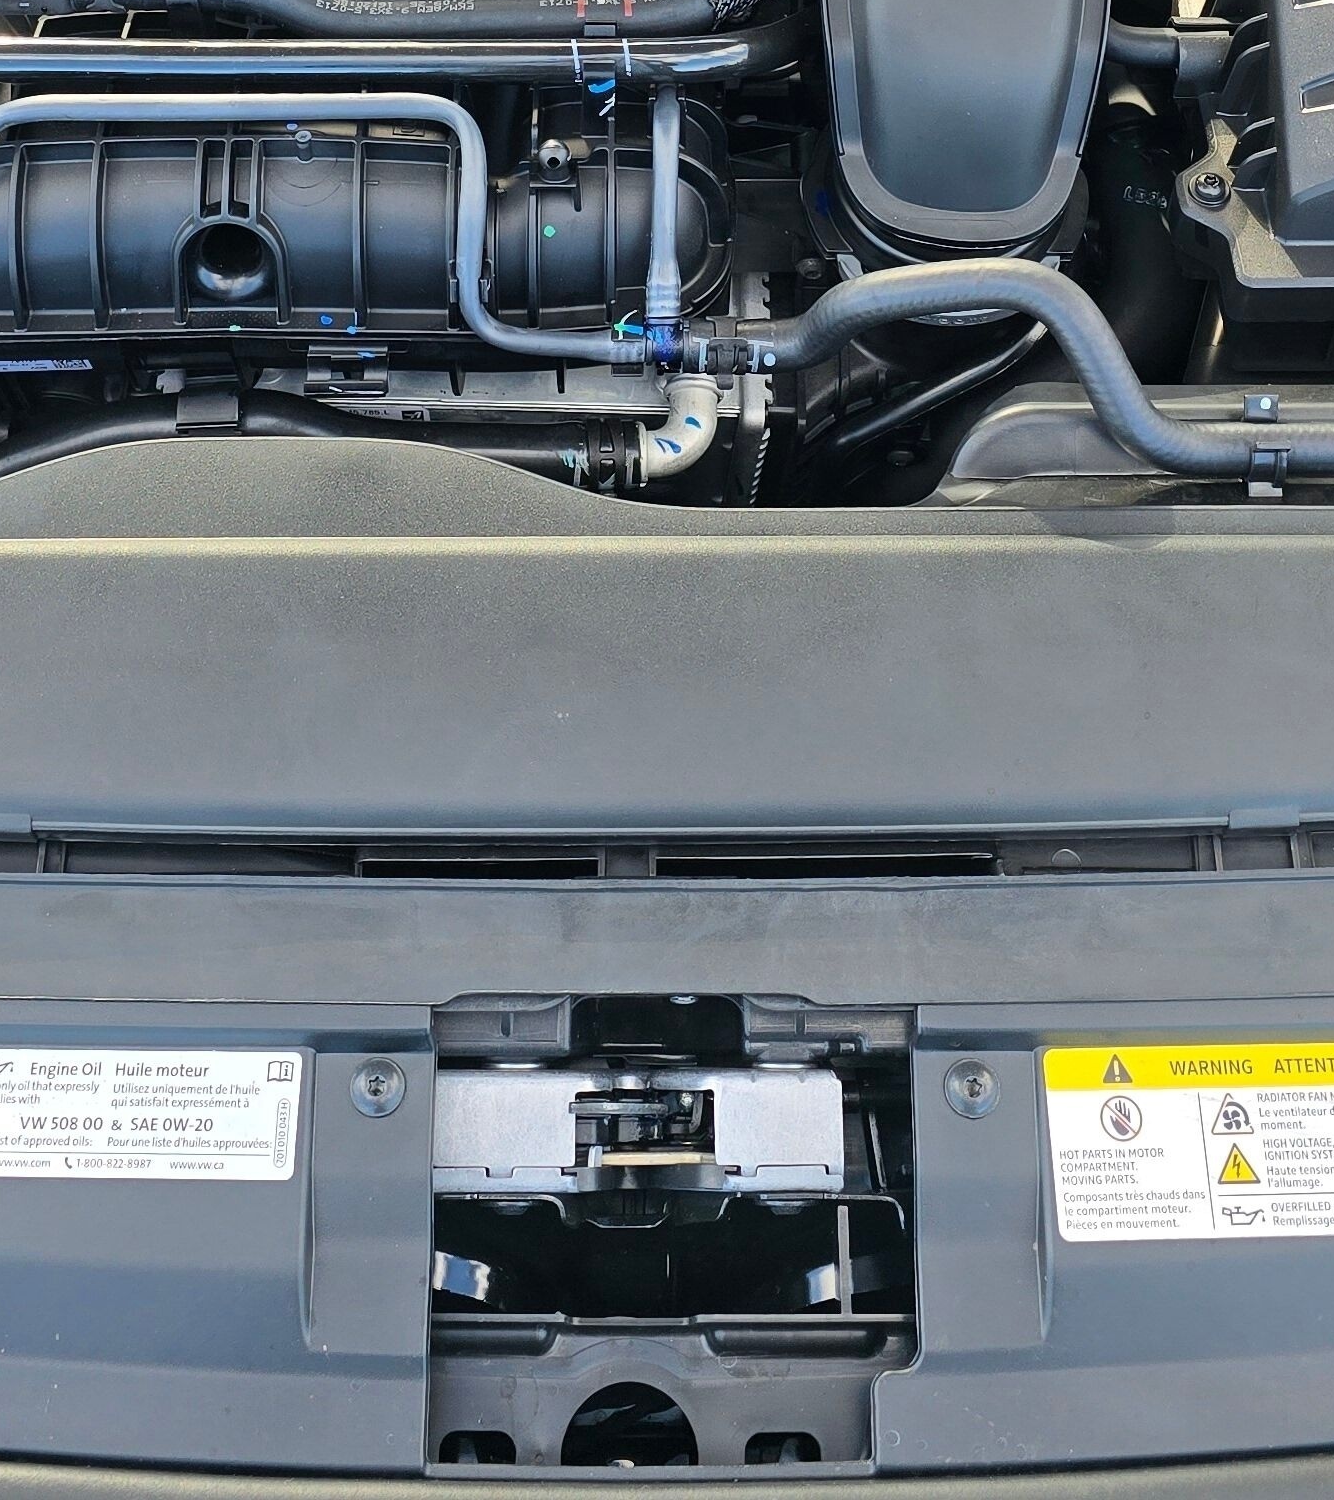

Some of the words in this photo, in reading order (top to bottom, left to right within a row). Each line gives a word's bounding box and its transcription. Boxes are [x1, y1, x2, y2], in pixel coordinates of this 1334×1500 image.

[30, 1062, 78, 1079] Engine
[82, 1062, 102, 1076] Oil
[115, 1062, 152, 1076] Huile
[156, 1064, 209, 1077] moteur
[1170, 1060, 1253, 1076] WARNING
[17, 1080, 30, 1091] oil
[32, 1081, 52, 1091] that
[54, 1081, 99, 1094] expressly
[113, 1083, 150, 1093] Utilisez
[152, 1084, 213, 1096] uniquement
[216, 1084, 227, 1095] de
[230, 1081, 260, 1095] l'huile
[18, 1094, 40, 1104] with
[1257, 1091, 1306, 1102] RADIATOR
[1308, 1091, 1327, 1101] FAN
[111, 1096, 127, 1110] qui
[129, 1097, 168, 1107] satisfait
[172, 1097, 241, 1110] expressément
[244, 1098, 249, 1108] à
[280, 1102, 288, 1110] H
[1259, 1108, 1270, 1117] Le
[1273, 1106, 1327, 1116] ventilateur
[20, 1117, 47, 1130] VW
[51, 1117, 78, 1130] 508
[83, 1117, 103, 1130] 00
[111, 1120, 122, 1130] &
[131, 1118, 159, 1131] SAE
[279, 1111, 287, 1129] 043
[1261, 1121, 1306, 1130] moment.
[14, 1135, 23, 1145] of
[23, 1136, 70, 1148] approved
[72, 1136, 92, 1146] oils:
[107, 1137, 129, 1147] Pour
[132, 1139, 150, 1147] une
[152, 1137, 172, 1147] liste
[174, 1137, 211, 1148] d'huiles
[213, 1137, 272, 1151] approuvées:
[278, 1131, 286, 1147] 010
[1263, 1139, 1287, 1148] HIGH
[1289, 1138, 1334, 1148] VOLTAGE,
[276, 1149, 285, 1163] 701
[1060, 1150, 1079, 1160] HOT
[1082, 1149, 1112, 1159] PARTS
[1116, 1149, 1126, 1158] IN
[1128, 1148, 1164, 1158] MOTOR
[1265, 1151, 1308, 1160] IGNITION
[76, 1158, 151, 1169] 1-800-822-8987
[170, 1161, 224, 1170] www.vw.ca
[1061, 1162, 1138, 1172] COMPARTMENT.
[1267, 1166, 1296, 1175] Haute
[1062, 1175, 1102, 1185] MOVING
[1105, 1175, 1139, 1184] PARTS.
[1268, 1177, 1323, 1189] l'allumage.
[1063, 1192, 1123, 1204] Composants
[1126, 1190, 1144, 1200] très
[1146, 1190, 1180, 1200] chauds
[1182, 1189, 1206, 1199] dans
[1065, 1206, 1073, 1216] le
[1076, 1205, 1148, 1217] compartiment
[1151, 1205, 1192, 1213] moteur.
[1271, 1201, 1330, 1212] OVERFILLED
[1066, 1219, 1097, 1229] Pièces
[1116, 1219, 1180, 1229] mouvement.
[1273, 1215, 1334, 1227] Remplissage
